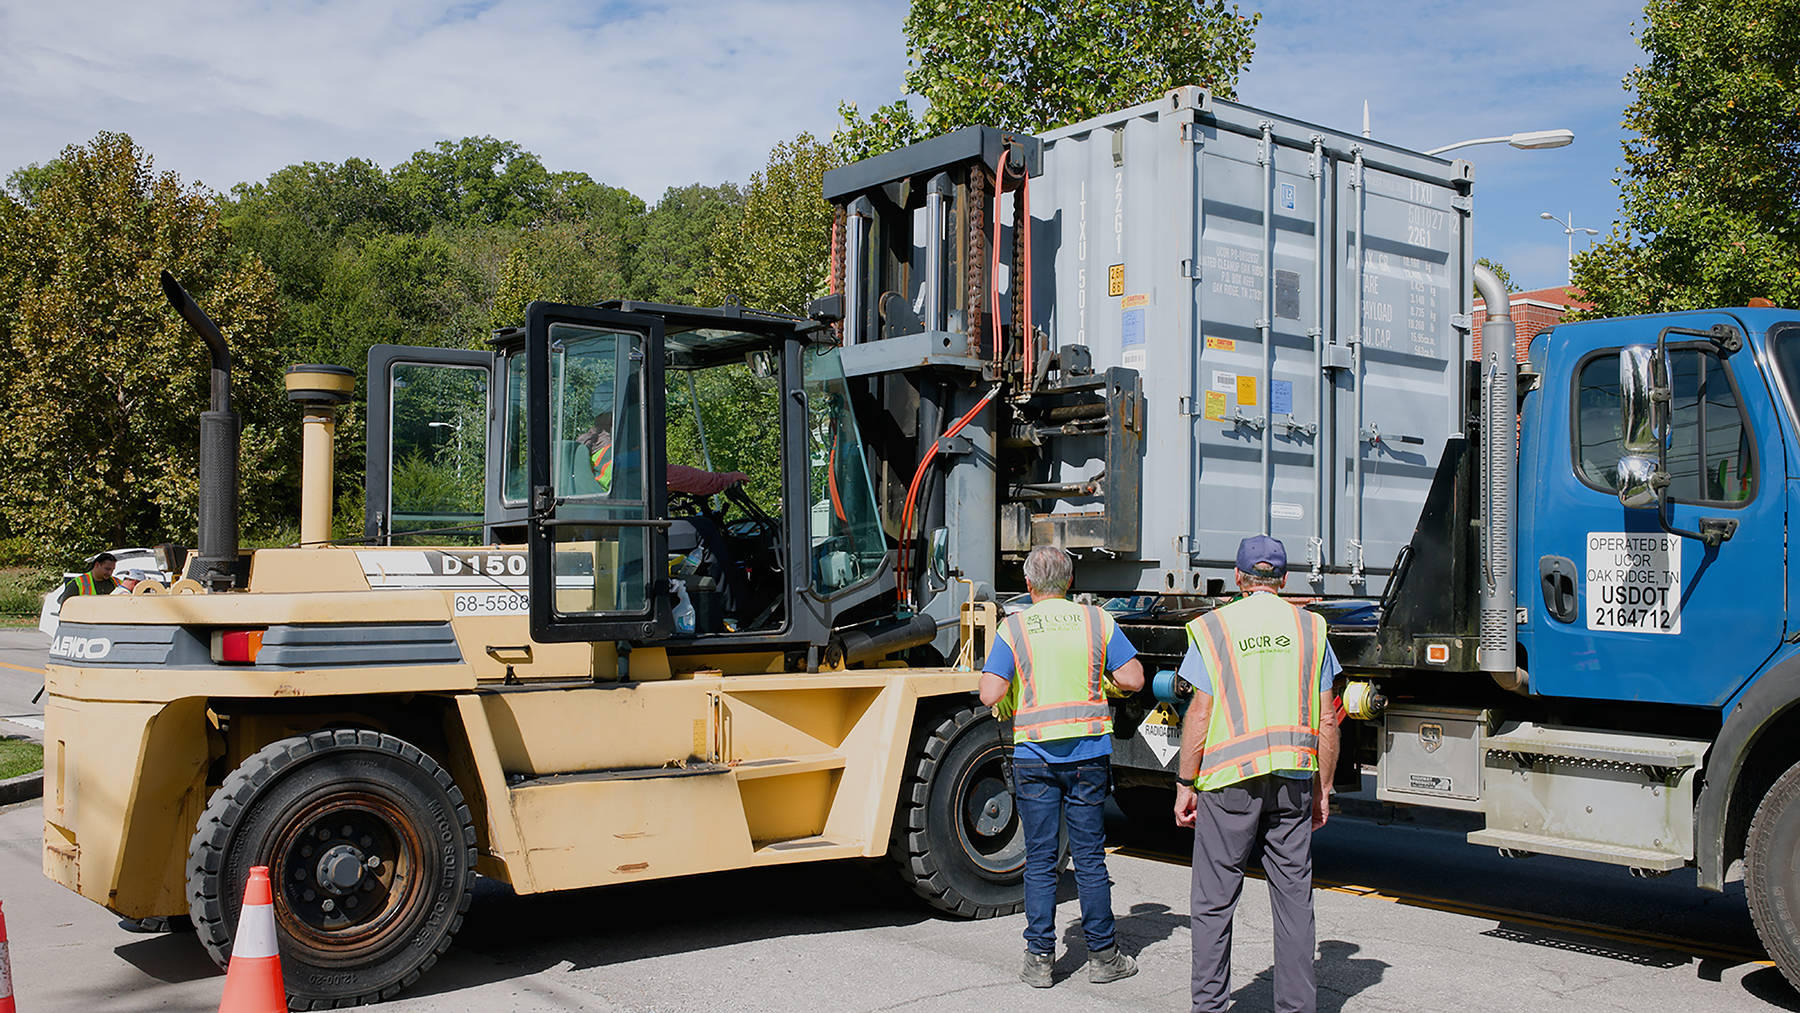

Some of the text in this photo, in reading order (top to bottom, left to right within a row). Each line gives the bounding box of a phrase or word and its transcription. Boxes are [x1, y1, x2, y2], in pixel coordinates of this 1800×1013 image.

[1410, 181, 1433, 204] ITXU
[1078, 181, 1086, 261] ITXU
[1408, 205, 1443, 230] 501027
[1408, 226, 1431, 249] 22G1
[1212, 282, 1223, 294] OAK
[1217, 338, 1232, 346] CAUTION
[1590, 538, 1678, 552] OPERATED BY
[442, 555, 526, 576] D150
[1614, 554, 1651, 567] UCOR
[1588, 569, 1679, 584] OAK RIDGE, TN
[456, 595, 530, 612] 68-5588
[1602, 586, 1670, 606] USDOT
[1044, 614, 1082, 623] UCOR
[1596, 608, 1670, 629] 2164712
[50, 635, 111, 659] AEWOO
[1238, 634, 1272, 652] UCOR
[1145, 724, 1182, 738] RADIOACTIV
[1162, 748, 1167, 758] 7
[428, 800, 452, 841] MITCO
[442, 841, 456, 888] SOLID
[309, 972, 358, 985] 12.00-20
